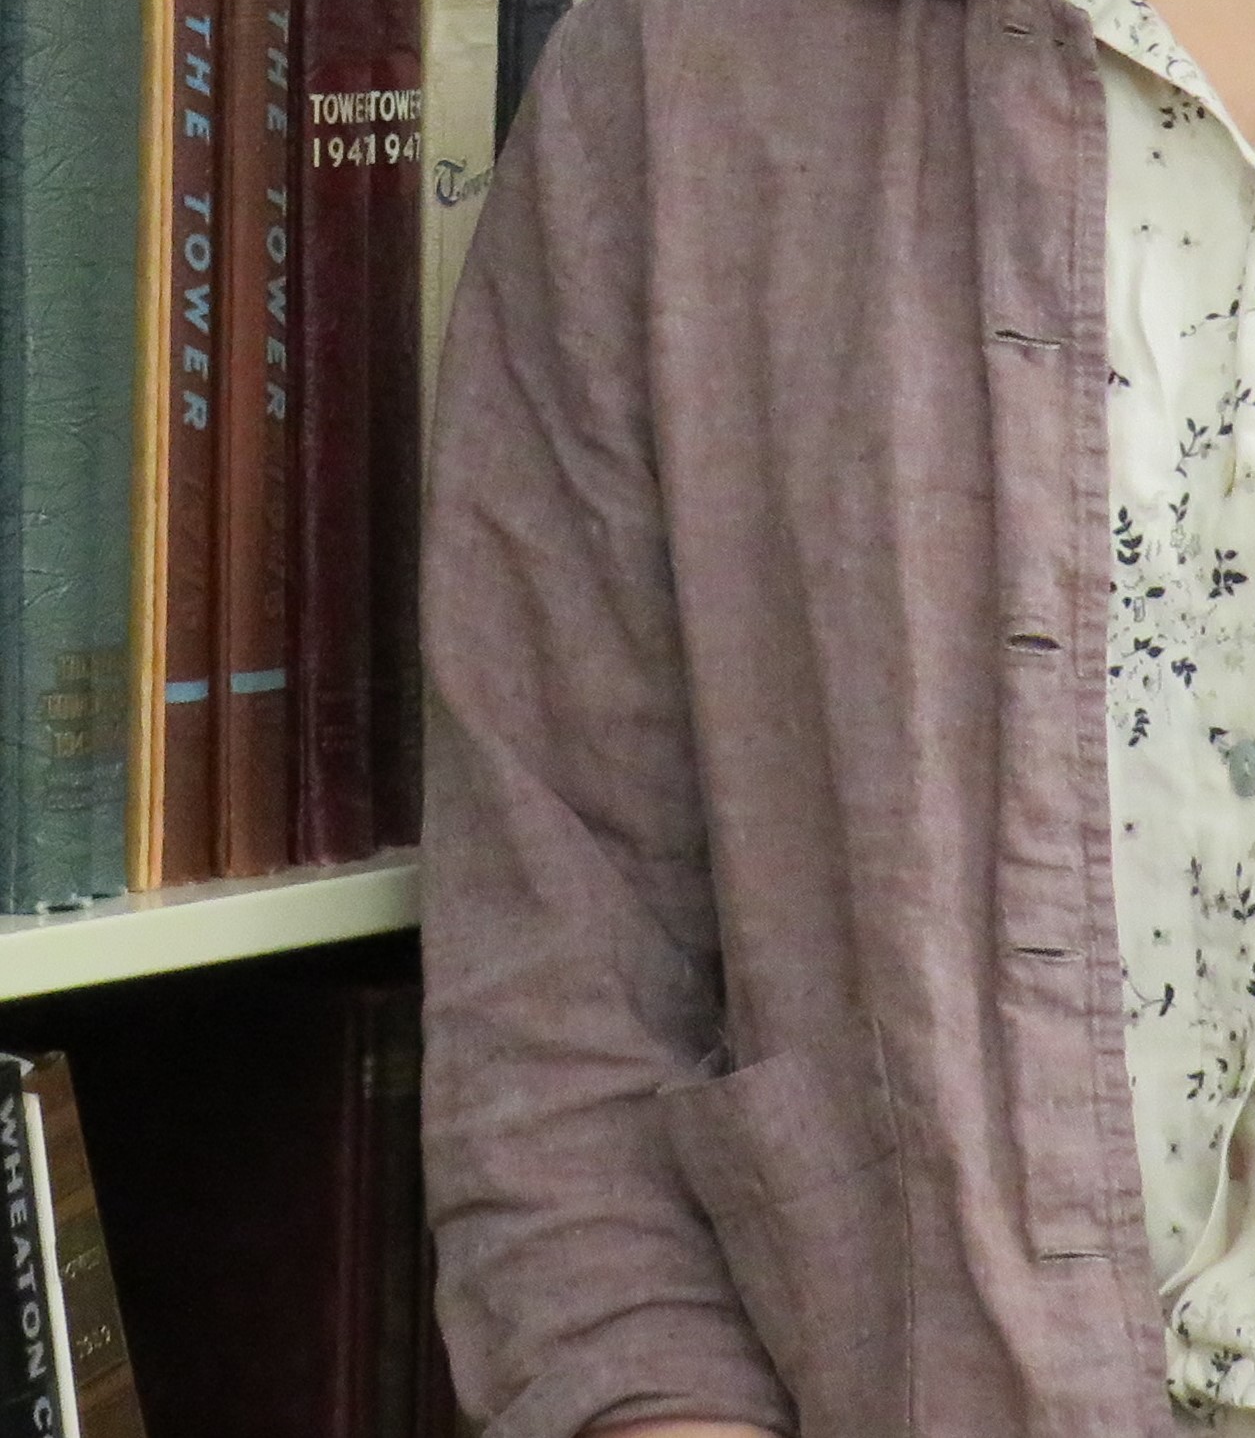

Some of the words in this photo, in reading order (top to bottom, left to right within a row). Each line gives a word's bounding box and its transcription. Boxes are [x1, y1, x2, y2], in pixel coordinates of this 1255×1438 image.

[184, 15, 212, 146] THE
[266, 10, 288, 139] THE
[184, 192, 212, 431] TOWER
[265, 184, 288, 421] TOWER
[0, 1096, 48, 1382] WHEATON
